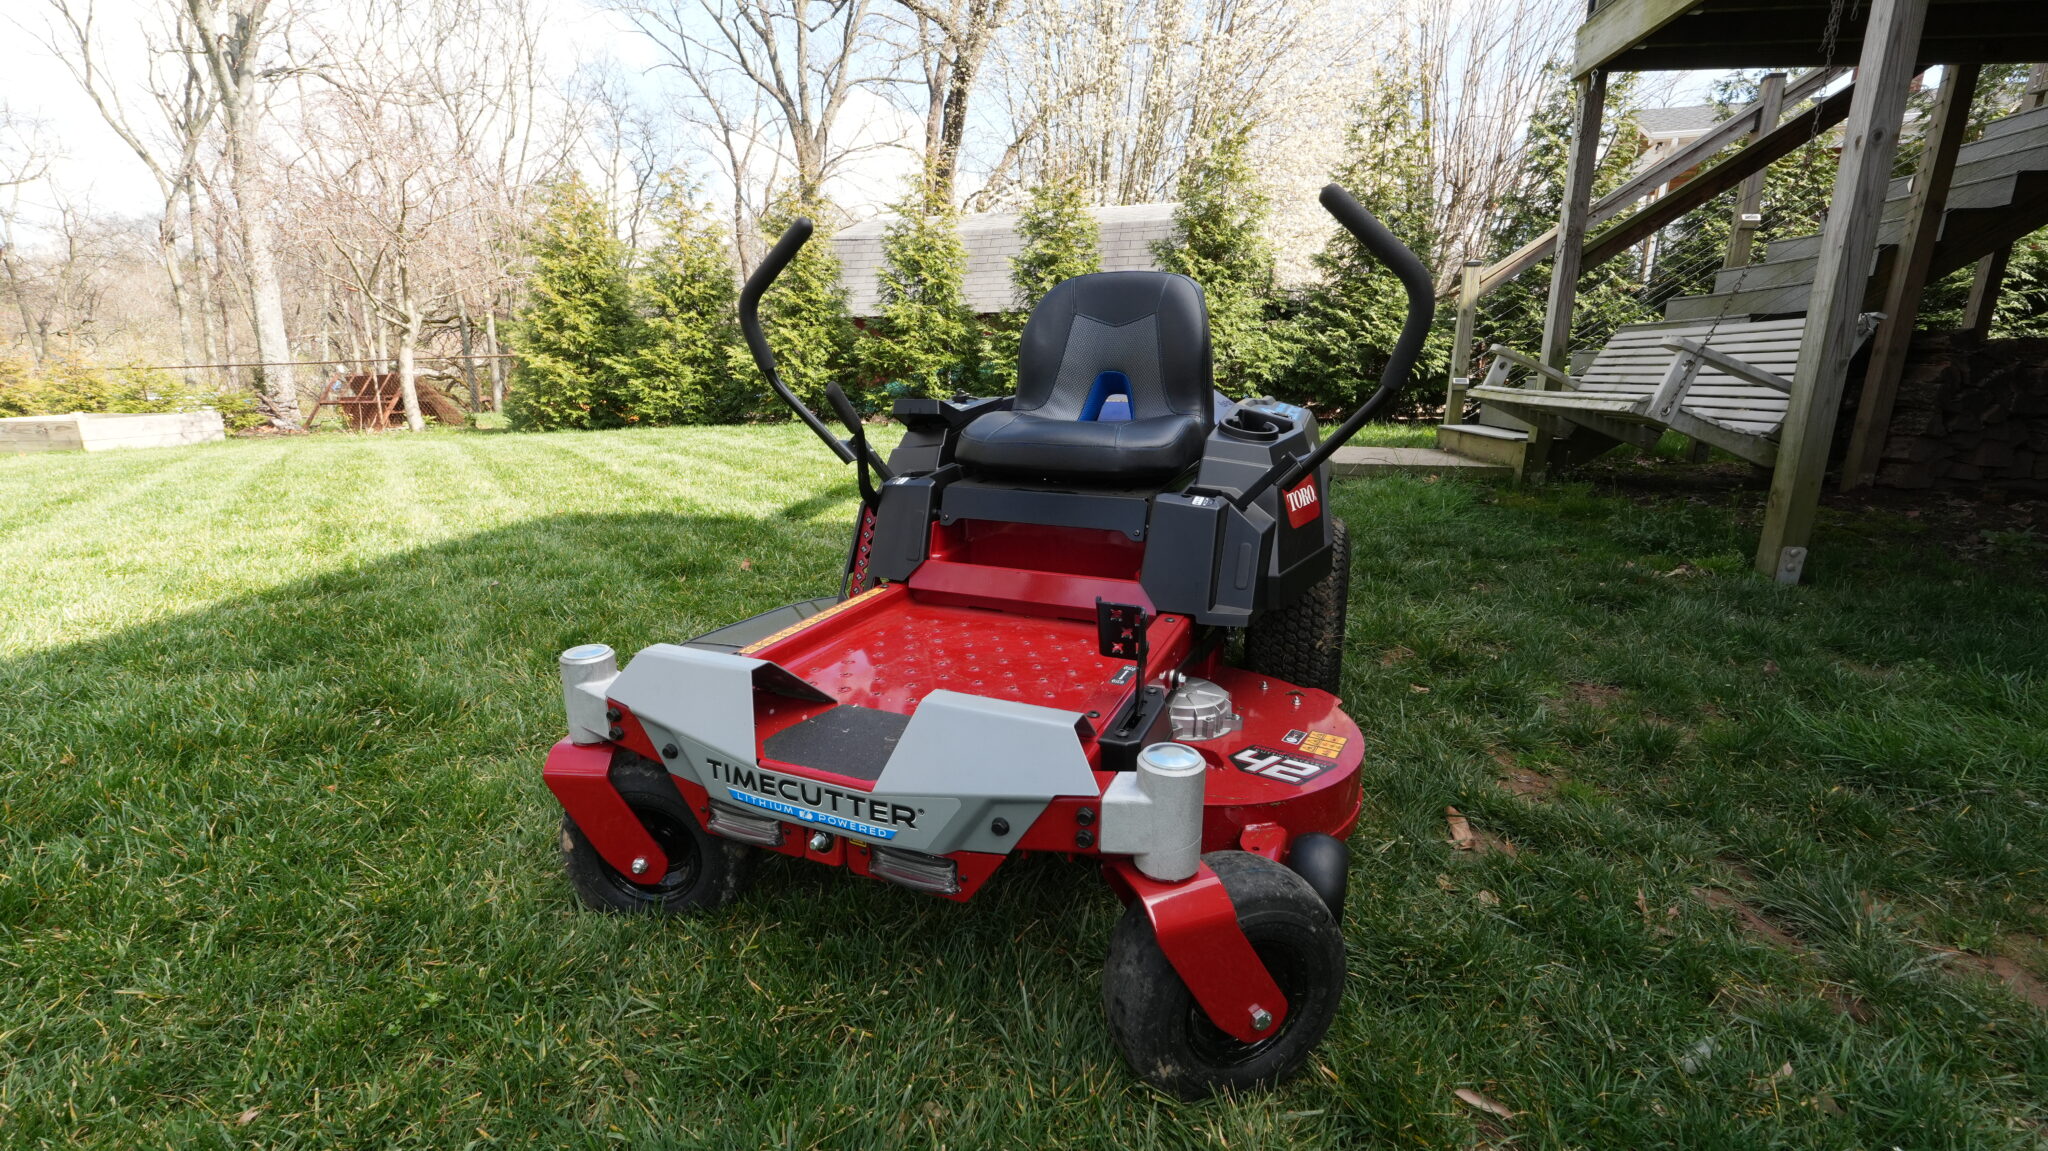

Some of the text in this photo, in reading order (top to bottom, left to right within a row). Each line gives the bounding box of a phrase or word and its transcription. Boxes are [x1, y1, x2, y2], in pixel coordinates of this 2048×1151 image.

[1286, 484, 1315, 512] TORO
[1234, 749, 1321, 783] 42
[706, 758, 918, 830] TIMECUTTER
[736, 791, 887, 838] LITHIUM POWERED
